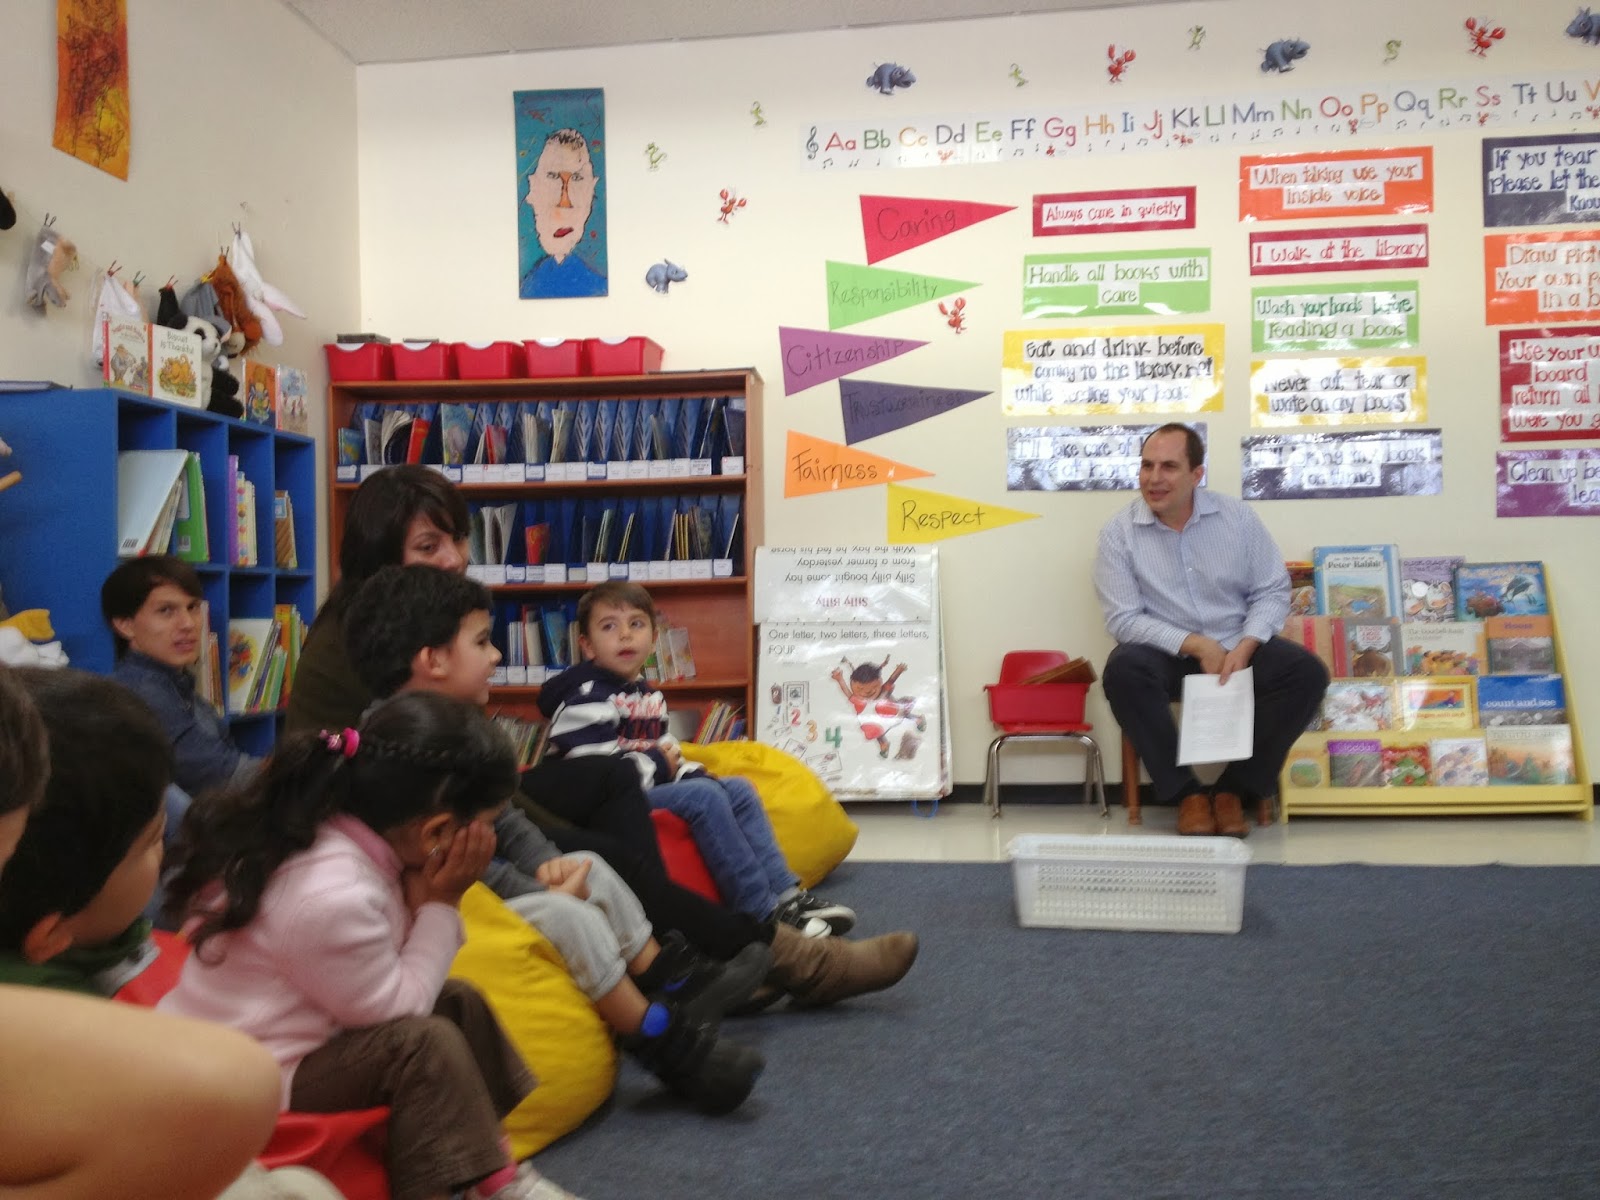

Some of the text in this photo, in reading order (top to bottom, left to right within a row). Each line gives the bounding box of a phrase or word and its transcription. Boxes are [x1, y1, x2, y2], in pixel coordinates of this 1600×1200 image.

[824, 131, 857, 151] Aa
[863, 128, 891, 150] Bb
[898, 126, 928, 148] Cc
[936, 122, 966, 145] Dd
[976, 121, 1003, 143] Ee
[1011, 117, 1036, 140] Ff
[1044, 116, 1077, 147] Gg
[1085, 114, 1115, 136] Hh
[1122, 112, 1135, 133] Ii
[1143, 110, 1164, 140] Jj
[1172, 107, 1200, 129] Kk
[1205, 105, 1225, 127] Ll
[1233, 102, 1275, 125] Mm
[1281, 99, 1312, 121] Nn
[1320, 96, 1354, 118] Oo
[1361, 93, 1390, 123] Pp
[1394, 90, 1434, 120] Qq
[1439, 87, 1468, 110] Rr
[1476, 85, 1501, 107] Ss
[1512, 83, 1538, 105] Tt
[1546, 81, 1577, 103] Uu
[1495, 146, 1598, 170] If you tear
[1254, 164, 1417, 185] When talking use your
[1550, 170, 1571, 190] let
[1286, 187, 1382, 204] inside voice
[1046, 206, 1083, 222] Always
[1121, 205, 1132, 217] in
[1138, 201, 1182, 218] quietly
[877, 207, 957, 241] Caring
[1256, 245, 1262, 263] I
[1320, 241, 1335, 259] at
[1341, 240, 1365, 258] the
[1376, 239, 1425, 257] library
[1510, 245, 1557, 265] Draw
[1030, 259, 1204, 284] Handle all books with
[831, 281, 938, 309] Responsibility
[1101, 289, 1137, 304] care
[1543, 290, 1562, 309] in
[1569, 293, 1580, 307] a
[1258, 297, 1294, 316] Wash
[1268, 319, 1406, 338] reading a book
[1026, 339, 1055, 359] Eat
[1062, 340, 1097, 357] and
[1103, 337, 1151, 357] drink
[1512, 341, 1545, 360] Use
[1548, 347, 1585, 361] your
[786, 339, 904, 377] Citizenship
[1104, 362, 1129, 379] the
[1535, 361, 1588, 382] board
[1394, 372, 1410, 389] or
[1119, 388, 1149, 403] your
[1515, 386, 1560, 405] return
[1574, 385, 1591, 403] all
[1556, 414, 1583, 429] you
[1386, 443, 1427, 462] book
[792, 448, 878, 483] Fairness
[1510, 460, 1554, 482] Clean
[1559, 467, 1578, 482] up
[902, 500, 986, 531] Respect
[848, 557, 879, 568] farmer
[892, 558, 916, 567] From
[1327, 560, 1351, 569] Peter
[785, 572, 803, 583] hay
[835, 572, 868, 584] bought
[895, 571, 916, 583] Silly
[844, 596, 868, 608] Silly
[768, 628, 930, 641] One letter, two letters, three letters,
[1485, 698, 1557, 707] count and see
[791, 708, 801, 726] 2
[806, 720, 818, 743] 3
[826, 726, 843, 748] 4
